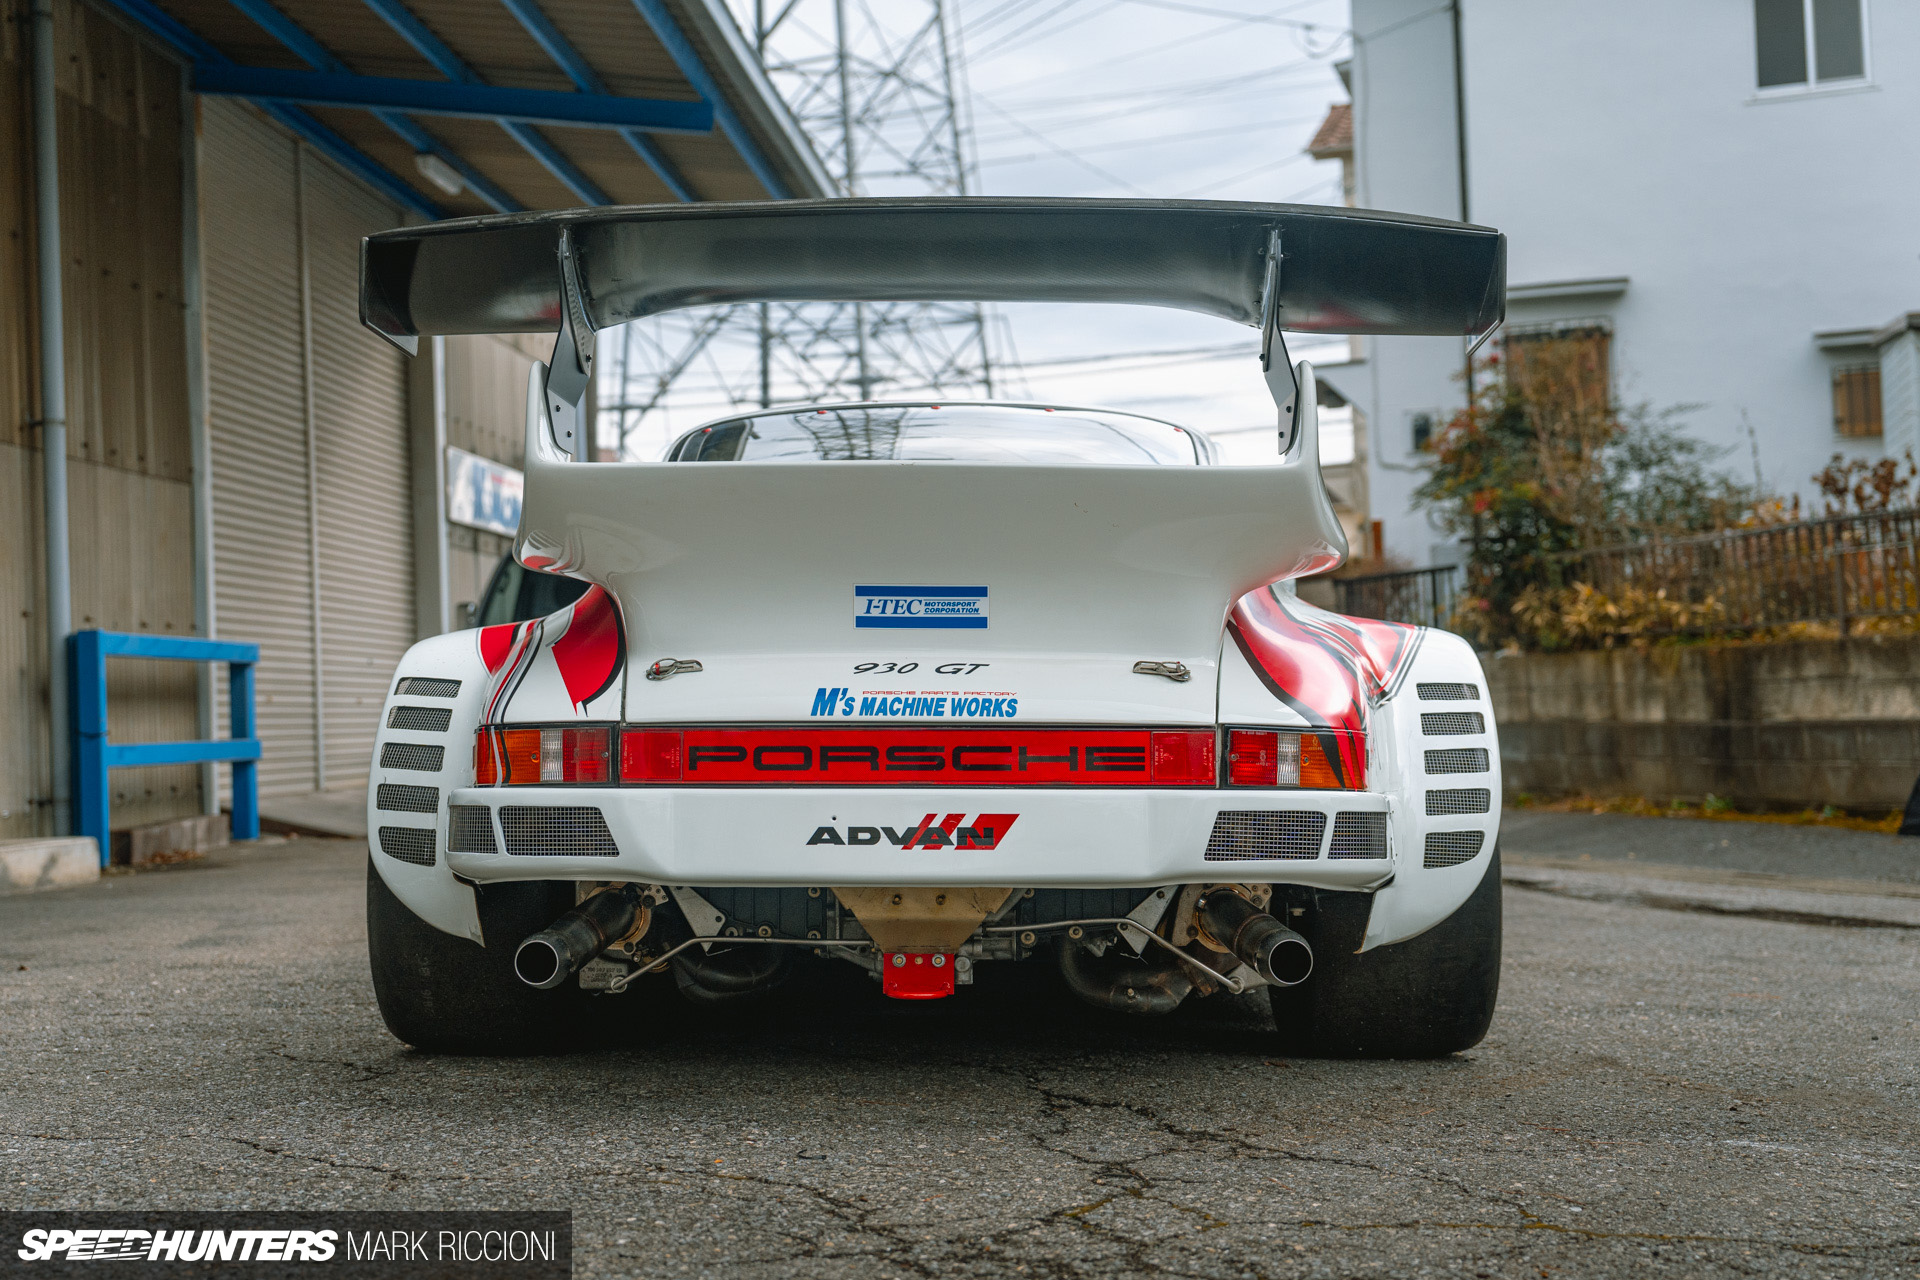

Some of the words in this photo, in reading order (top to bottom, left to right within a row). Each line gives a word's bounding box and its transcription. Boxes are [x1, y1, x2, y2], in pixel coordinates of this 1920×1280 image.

[864, 598, 922, 615] I-TEC
[853, 662, 919, 675] 930
[934, 663, 990, 675] GT
[810, 687, 855, 717] M's
[858, 696, 947, 717] MACHINE
[950, 697, 1018, 718] WORKS
[688, 745, 1146, 772] PORSCHE
[806, 826, 994, 846] ADVAN
